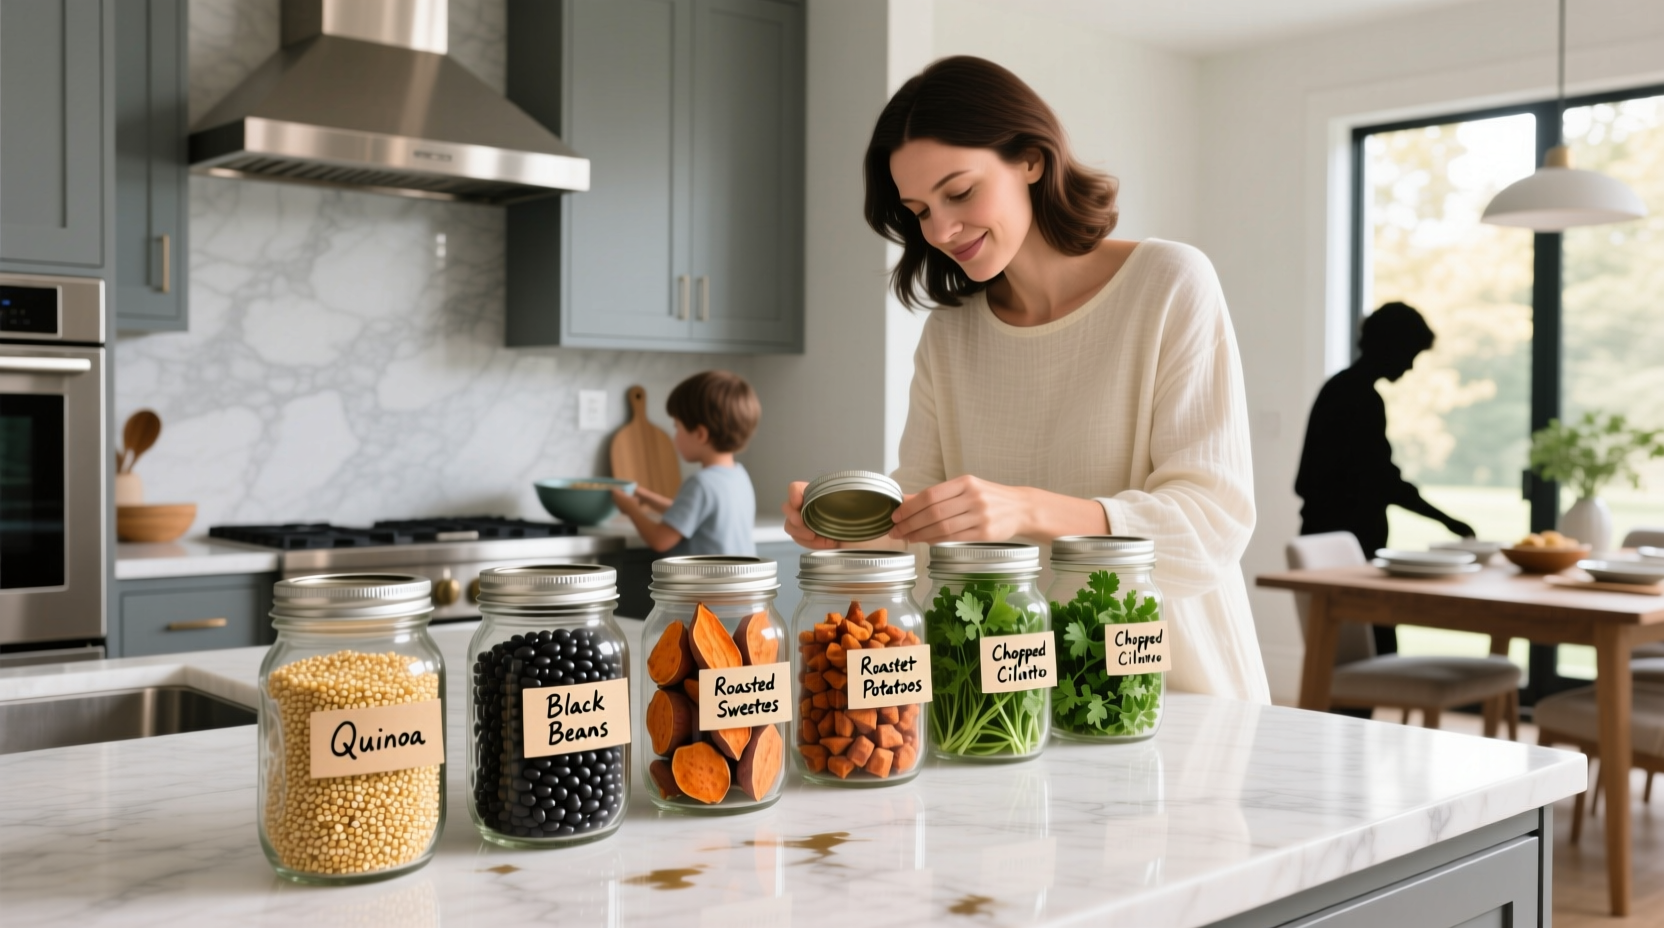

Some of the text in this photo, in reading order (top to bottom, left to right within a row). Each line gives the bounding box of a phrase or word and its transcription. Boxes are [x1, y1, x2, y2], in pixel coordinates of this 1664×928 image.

[714, 672, 775, 697] Roasted
[546, 689, 605, 719] Black
[330, 720, 426, 761] Quinoa
[548, 720, 609, 746] Beans
